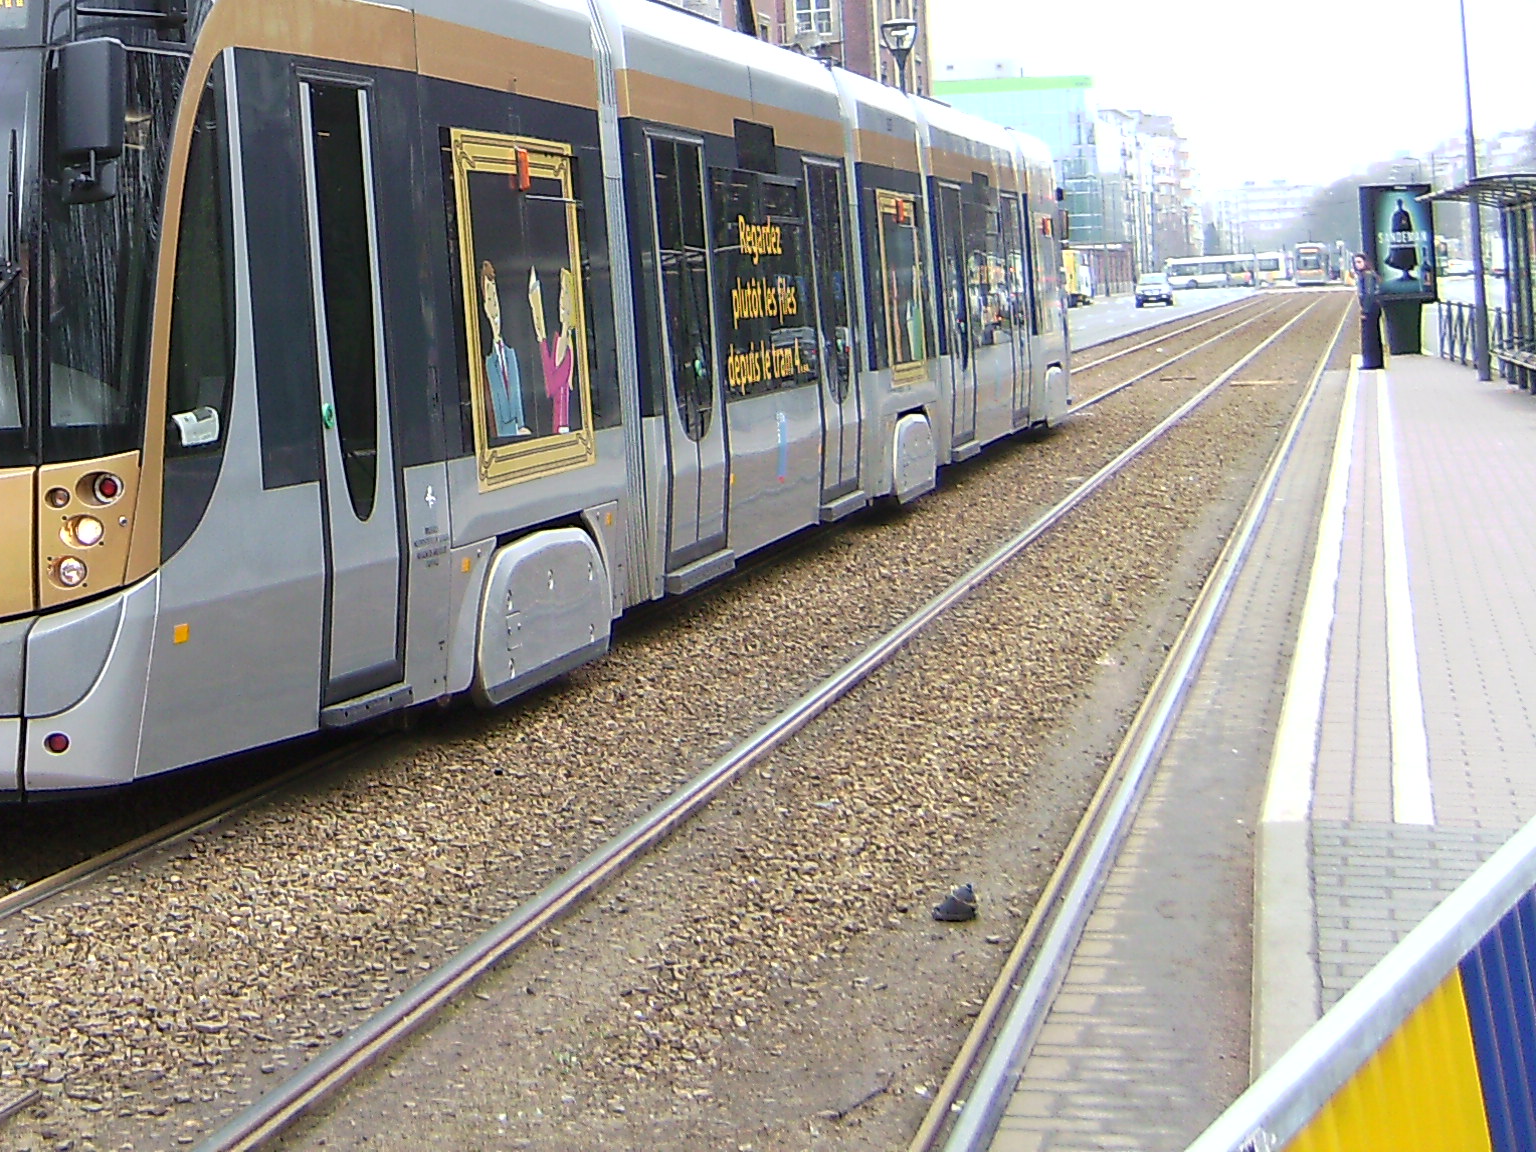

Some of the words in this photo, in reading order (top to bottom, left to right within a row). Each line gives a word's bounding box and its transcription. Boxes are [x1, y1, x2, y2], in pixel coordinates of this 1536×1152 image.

[738, 214, 782, 265] Regardez
[732, 276, 763, 330] plutôt
[763, 276, 777, 316] les
[728, 341, 760, 395] depuis
[761, 339, 771, 380] le
[772, 343, 794, 378] tram
